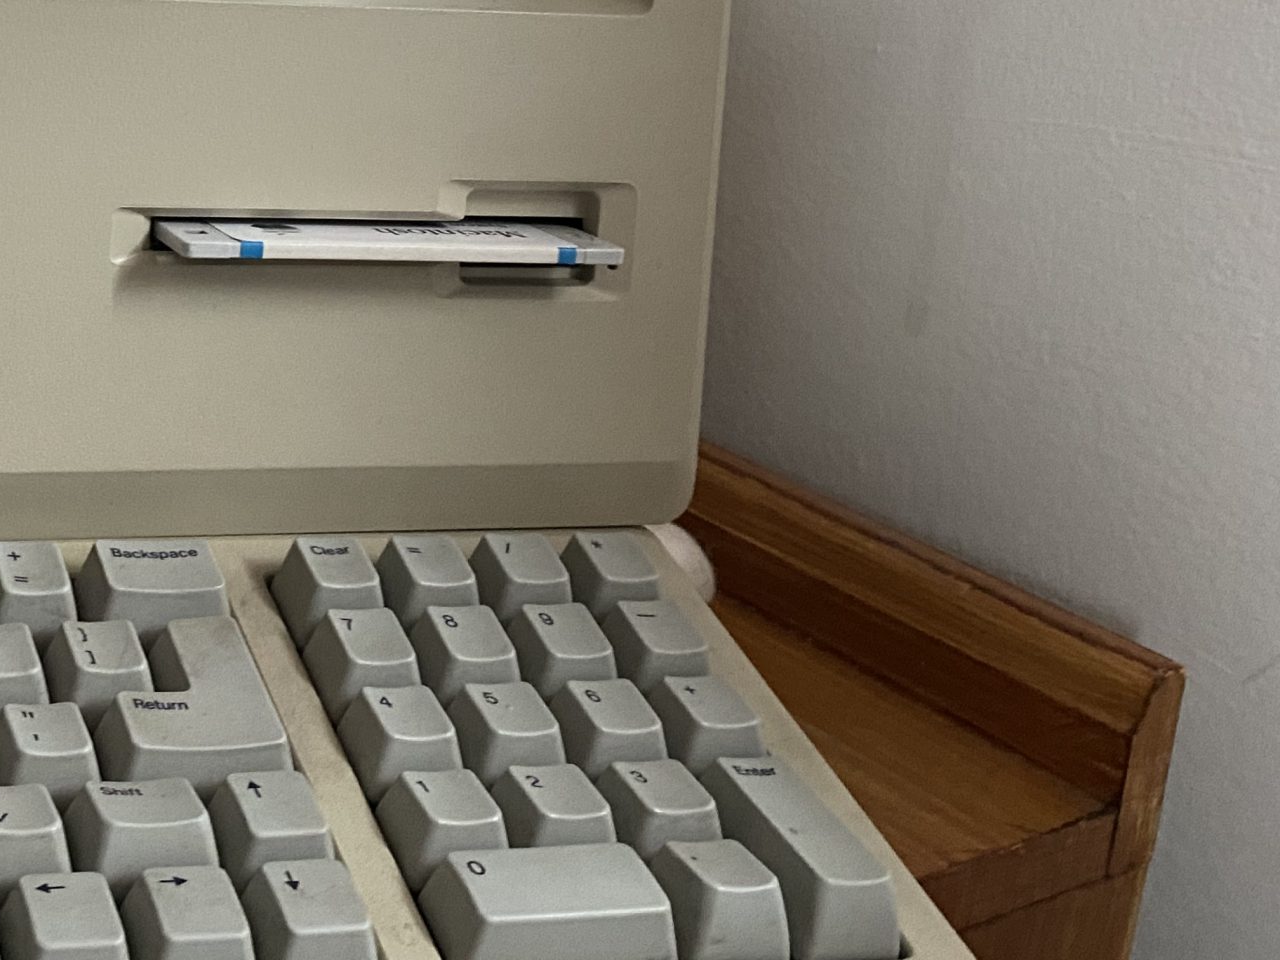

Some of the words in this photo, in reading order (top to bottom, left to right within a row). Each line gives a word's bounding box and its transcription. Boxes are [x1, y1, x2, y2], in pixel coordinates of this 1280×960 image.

[373, 226, 528, 240] Macintosh
[110, 547, 199, 561] Backspace
[309, 543, 351, 556] Clear
[340, 617, 354, 631] 7
[442, 614, 458, 628] 8
[539, 612, 554, 626] 9
[379, 696, 394, 709] 4
[482, 691, 499, 705] 5
[586, 689, 602, 703] 6
[132, 698, 189, 711] Return
[630, 770, 648, 784] 3
[732, 765, 776, 777] Enter
[415, 780, 430, 793] 1
[525, 775, 544, 790] 2
[99, 785, 143, 798] Shift
[467, 860, 486, 876] 0
